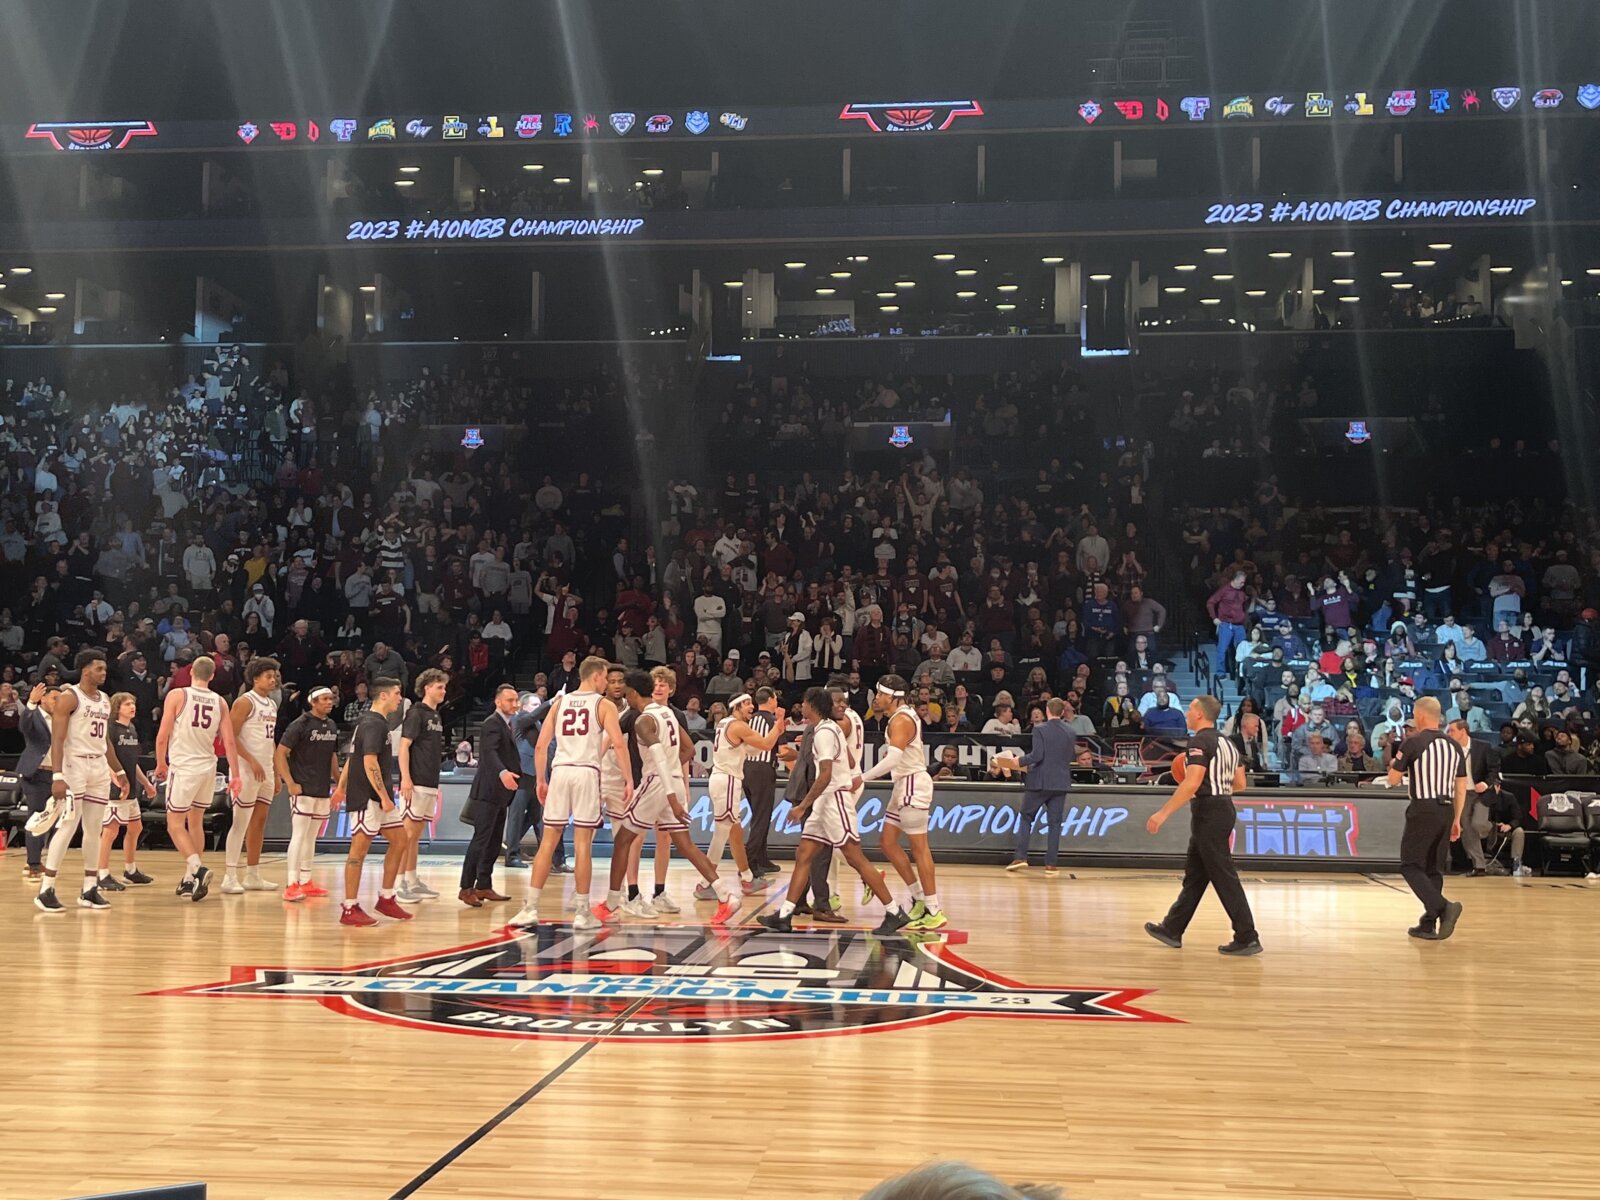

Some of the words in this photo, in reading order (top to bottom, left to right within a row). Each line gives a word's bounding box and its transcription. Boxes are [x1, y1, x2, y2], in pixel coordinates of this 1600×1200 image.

[1222, 103, 1255, 119] MASON
[1264, 95, 1295, 116] GW
[1355, 92, 1374, 115] L
[1385, 96, 1417, 107] MASS
[1534, 98, 1560, 108] SJU
[405, 118, 433, 138] GW
[487, 116, 504, 138] L
[515, 120, 543, 130] MASS
[647, 123, 669, 133] SJU
[726, 112, 748, 131] VCU
[367, 125, 397, 140] MASON
[1204, 202, 1263, 224] 2023
[1269, 199, 1382, 222] #A10MBB
[1386, 198, 1537, 219] CHAMPIONSHIP
[346, 220, 398, 240] 2023
[405, 218, 504, 239] #A10MBB
[509, 217, 644, 237] CHAMPIONSHIP
[1541, 660, 1568, 668] A10
[569, 700, 587, 708] KELLY
[191, 703, 214, 730] 15
[562, 708, 590, 737] 23
[90, 720, 105, 739] 30
[265, 723, 275, 739] 12
[667, 720, 678, 747] 2
[0, 776, 18, 784] 10
[857, 797, 1129, 836] CMPIONHIP
[308, 979, 354, 988] 20
[364, 980, 979, 1004] CHAMPIONSHIP
[989, 996, 1031, 1005] 23
[587, 976, 759, 989] MEN'S
[448, 1011, 792, 1033] BROOKLYN
